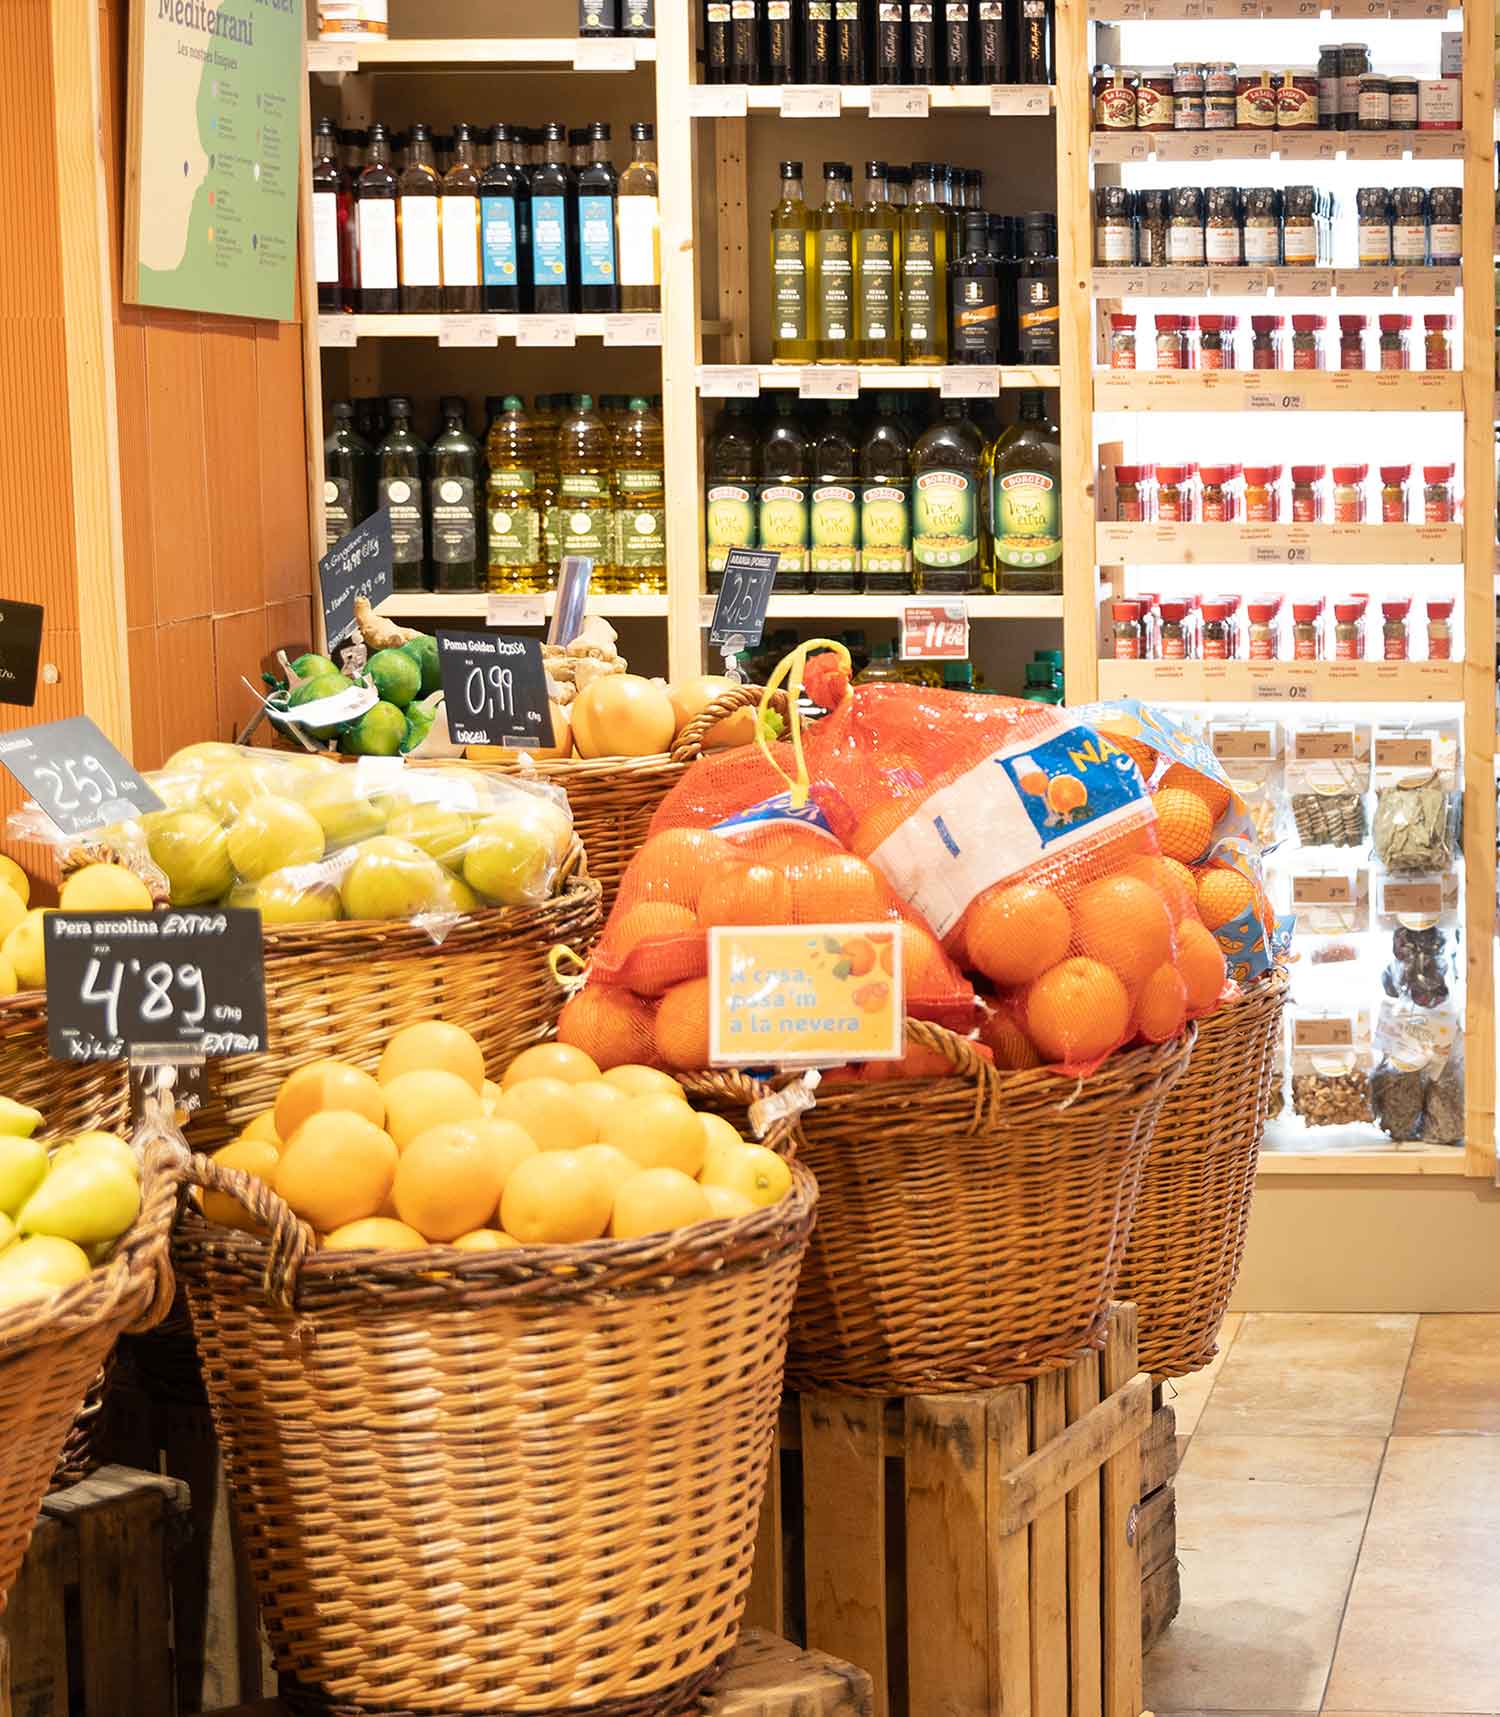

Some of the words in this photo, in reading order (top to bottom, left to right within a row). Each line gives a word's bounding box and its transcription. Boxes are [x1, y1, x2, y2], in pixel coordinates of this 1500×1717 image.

[443, 638, 468, 651] Poma
[468, 641, 496, 653] Golden
[467, 665, 514, 719] 0,99
[56, 918, 92, 935] Pera
[94, 917, 158, 935] ercolina
[162, 914, 227, 934] EXTRA
[81, 957, 206, 1037] 4'89
[214, 1004, 242, 1022] €/kg
[730, 1019, 742, 1032] a
[751, 1013, 772, 1032] la
[779, 1017, 859, 1032] nevera
[201, 1033, 259, 1053] EXTRA
